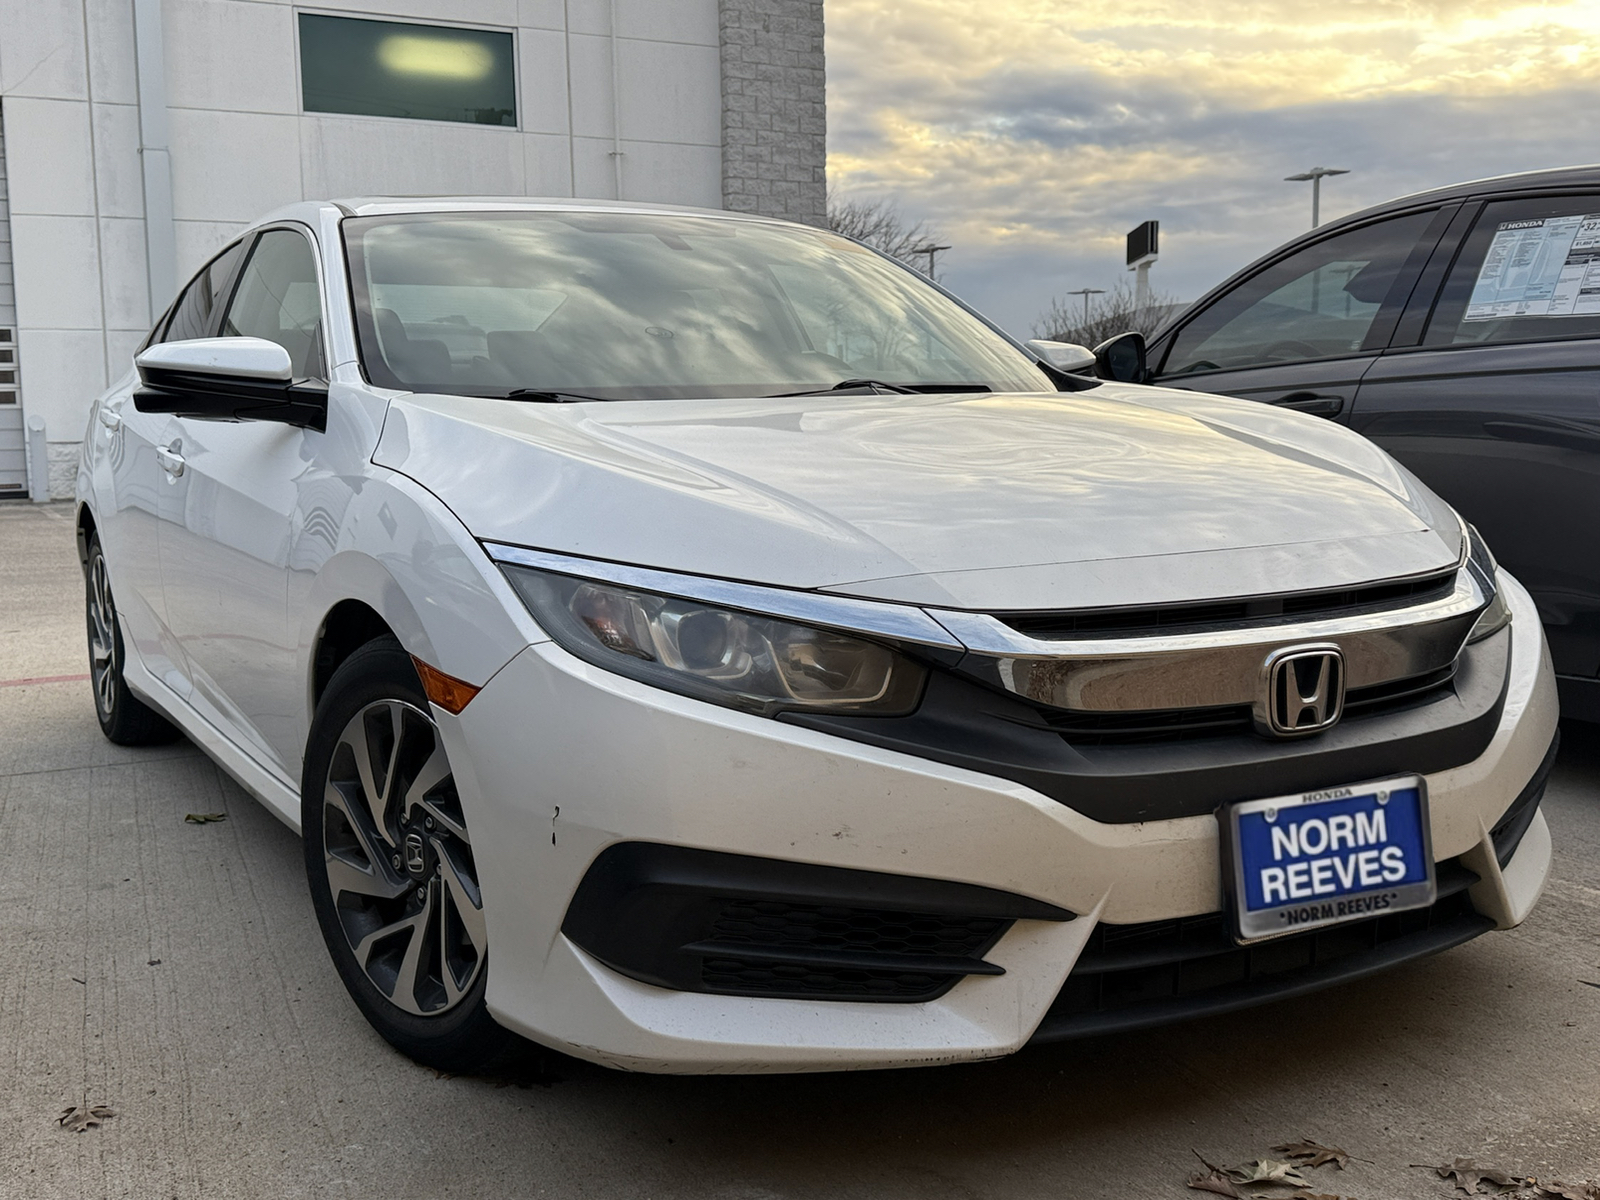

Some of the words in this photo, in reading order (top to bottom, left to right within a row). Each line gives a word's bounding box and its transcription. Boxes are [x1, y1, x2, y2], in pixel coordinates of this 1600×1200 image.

[1507, 220, 1543, 230] HONDA
[1302, 788, 1353, 803] HONDA
[1271, 808, 1387, 861] NORM
[1261, 846, 1407, 903] REEVES
[1288, 906, 1335, 925] NORM
[1337, 895, 1391, 917] REEVES
